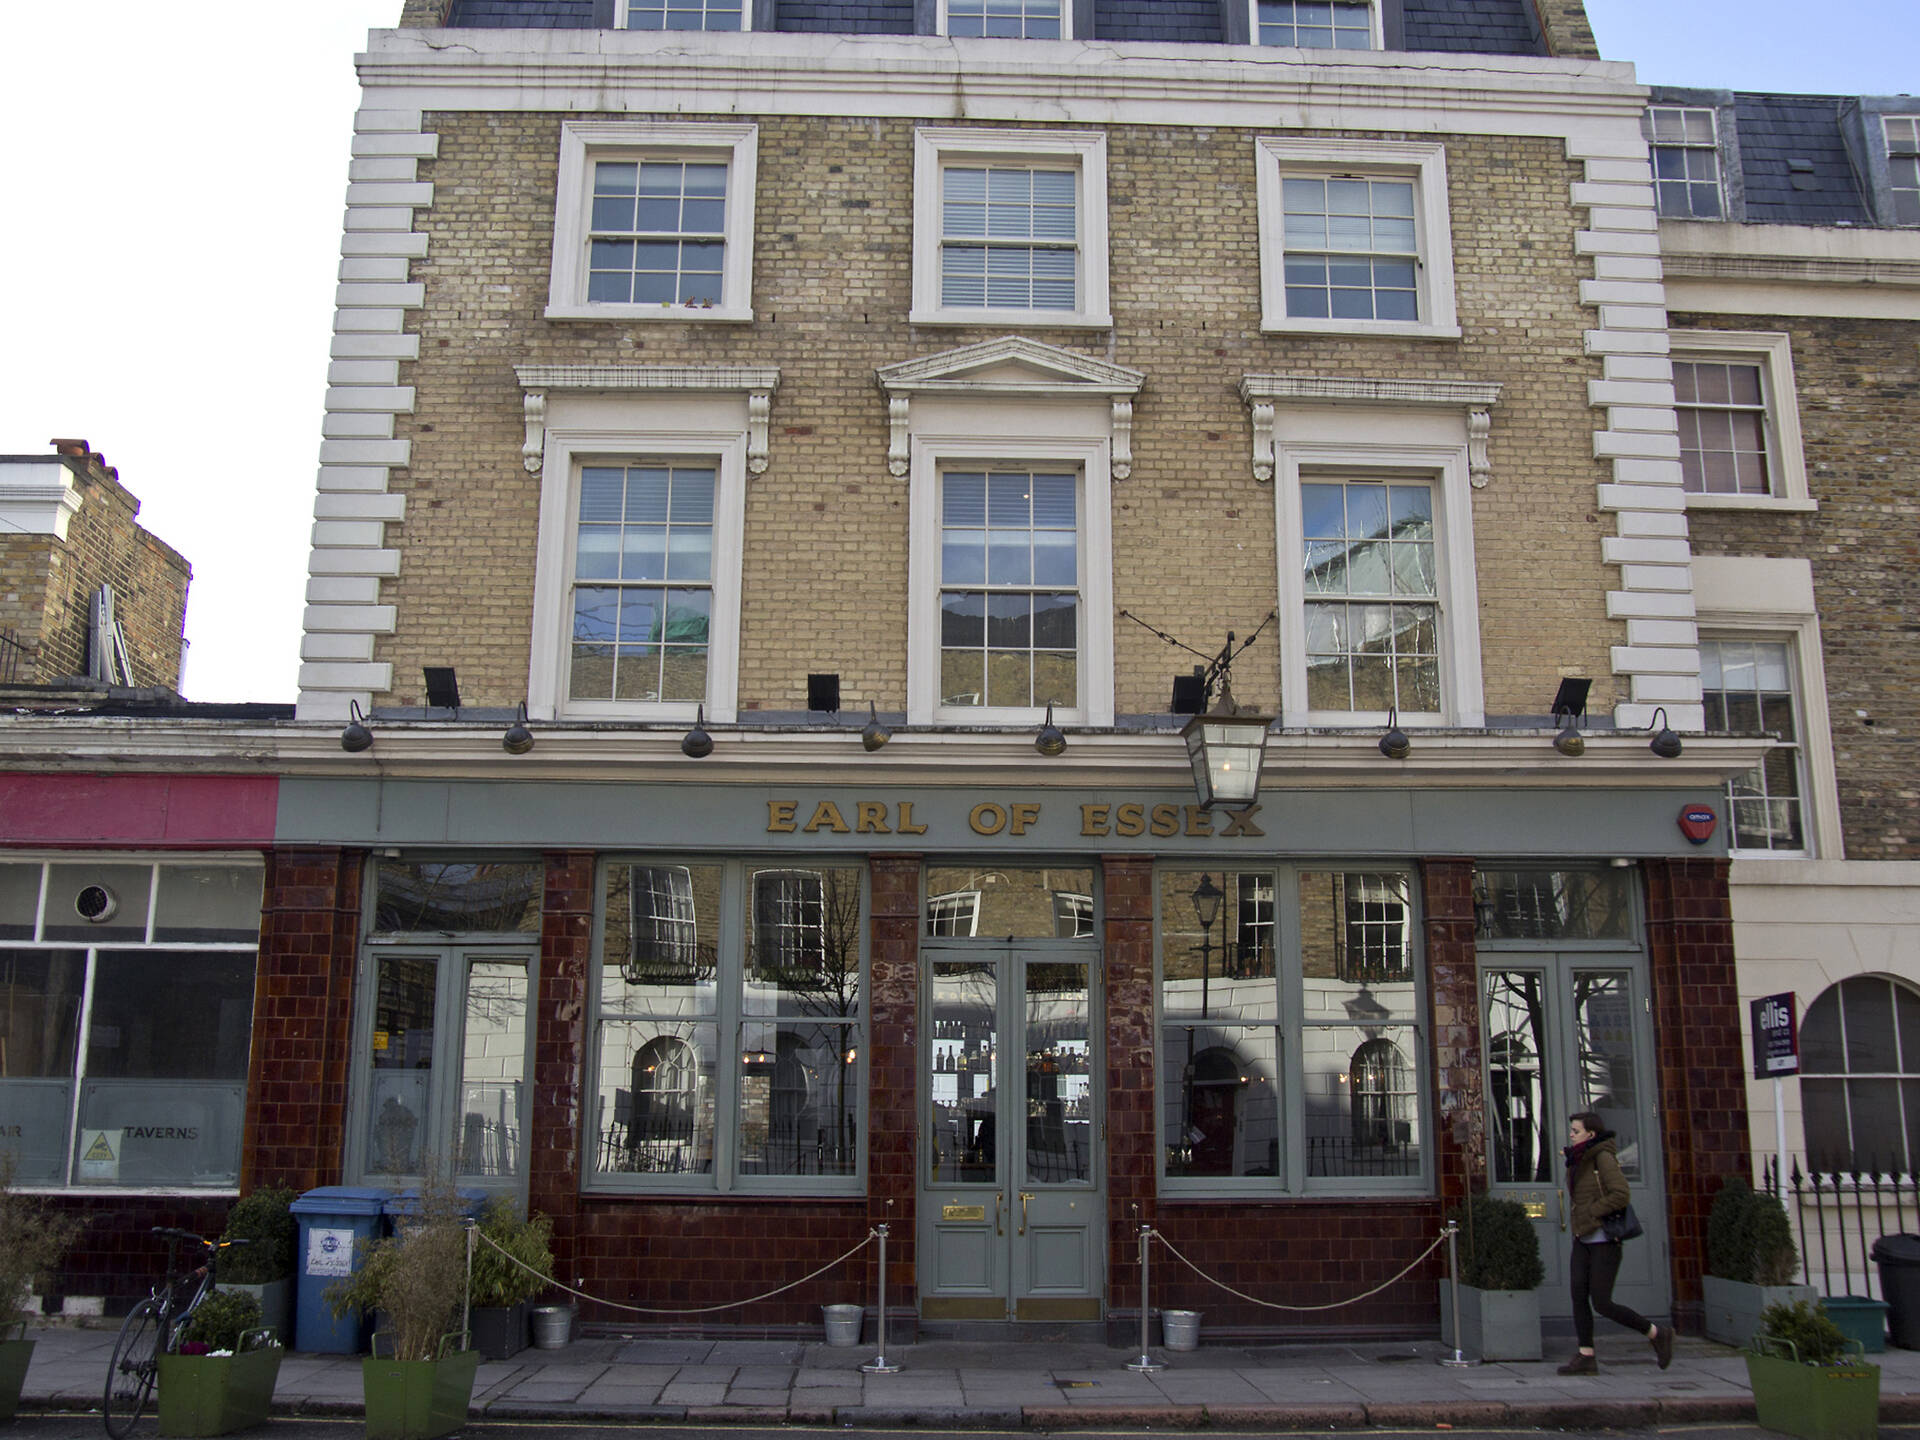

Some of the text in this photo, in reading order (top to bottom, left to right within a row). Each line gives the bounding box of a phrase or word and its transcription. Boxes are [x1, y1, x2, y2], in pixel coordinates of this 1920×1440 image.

[767, 801, 1265, 837] EARL OF ESSEX
[1760, 1001, 1789, 1030] ellis
[124, 1126, 198, 1140] TAVERNS
